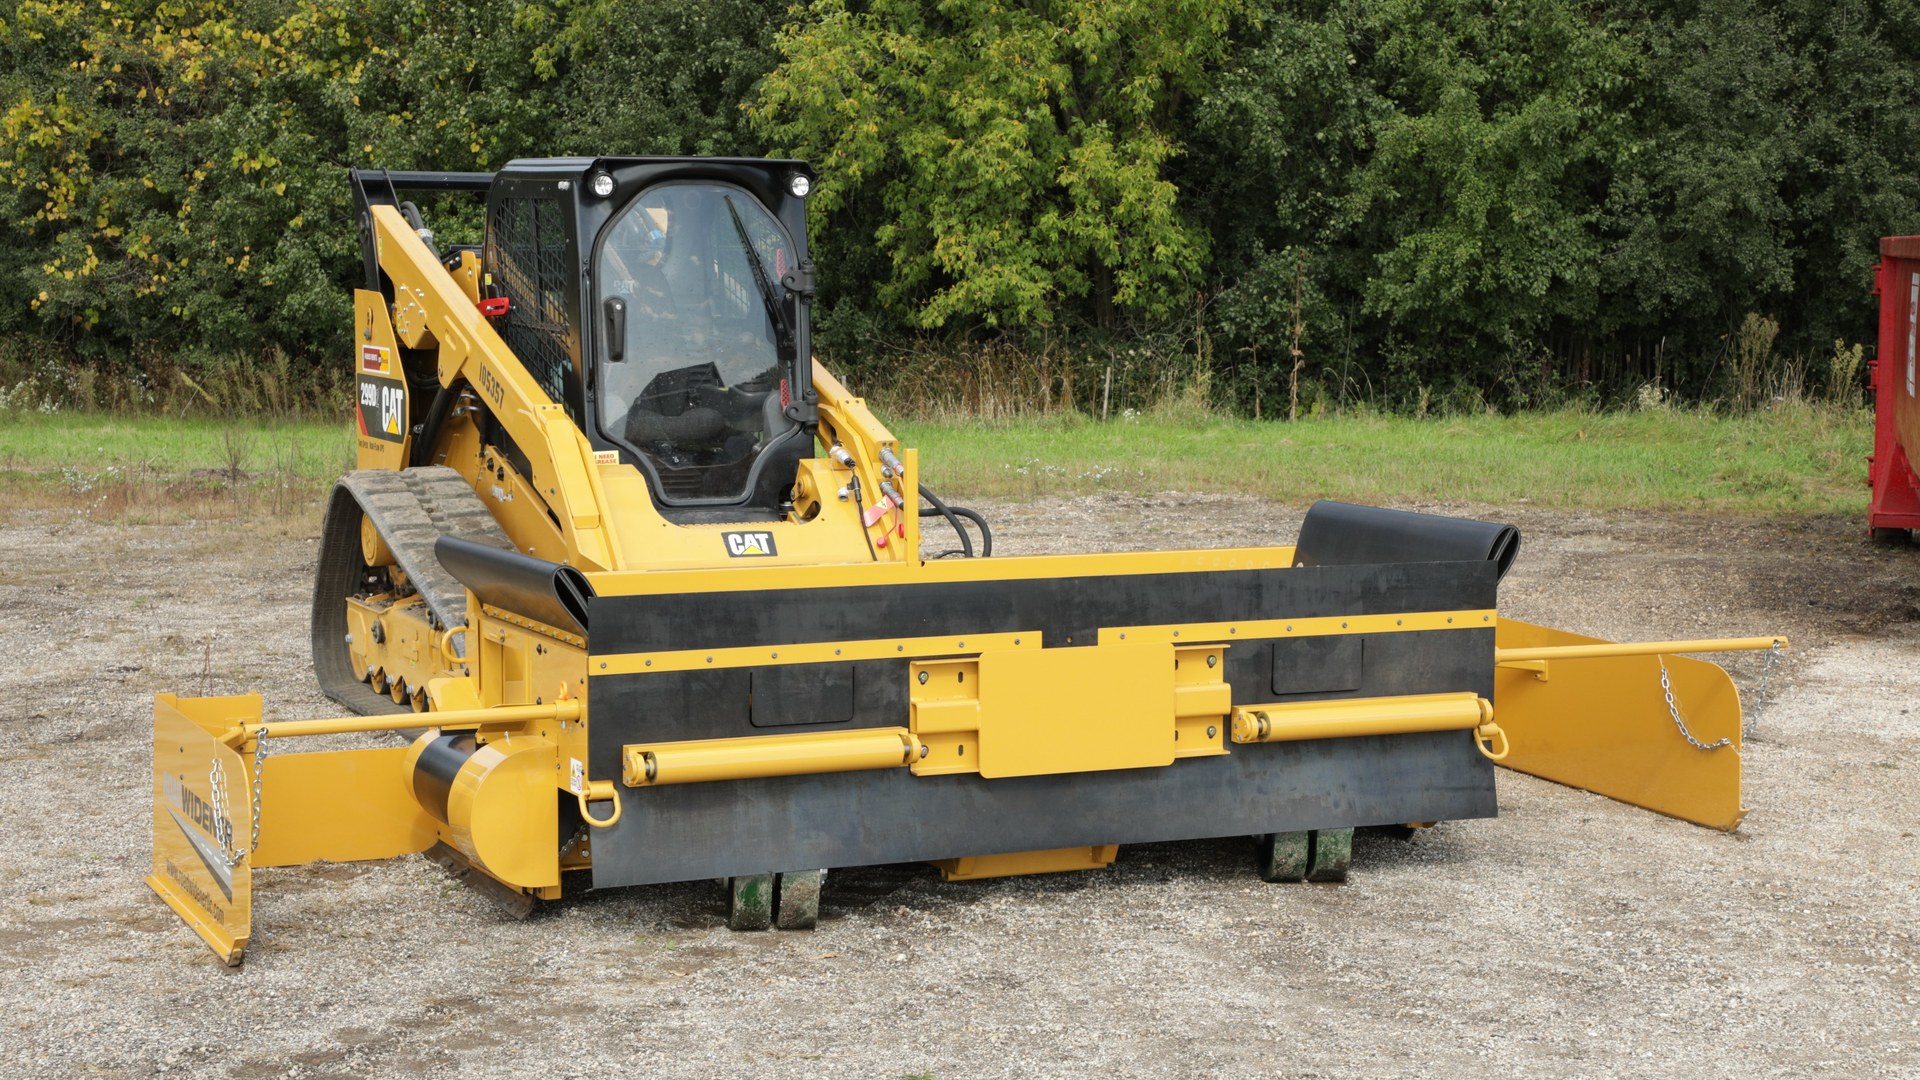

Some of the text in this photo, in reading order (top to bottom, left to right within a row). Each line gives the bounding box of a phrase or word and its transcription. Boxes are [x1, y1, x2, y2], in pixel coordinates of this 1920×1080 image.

[614, 280, 635, 293] CAT
[479, 361, 504, 409] 105357
[382, 386, 403, 435] CAT
[728, 533, 770, 555] CAT
